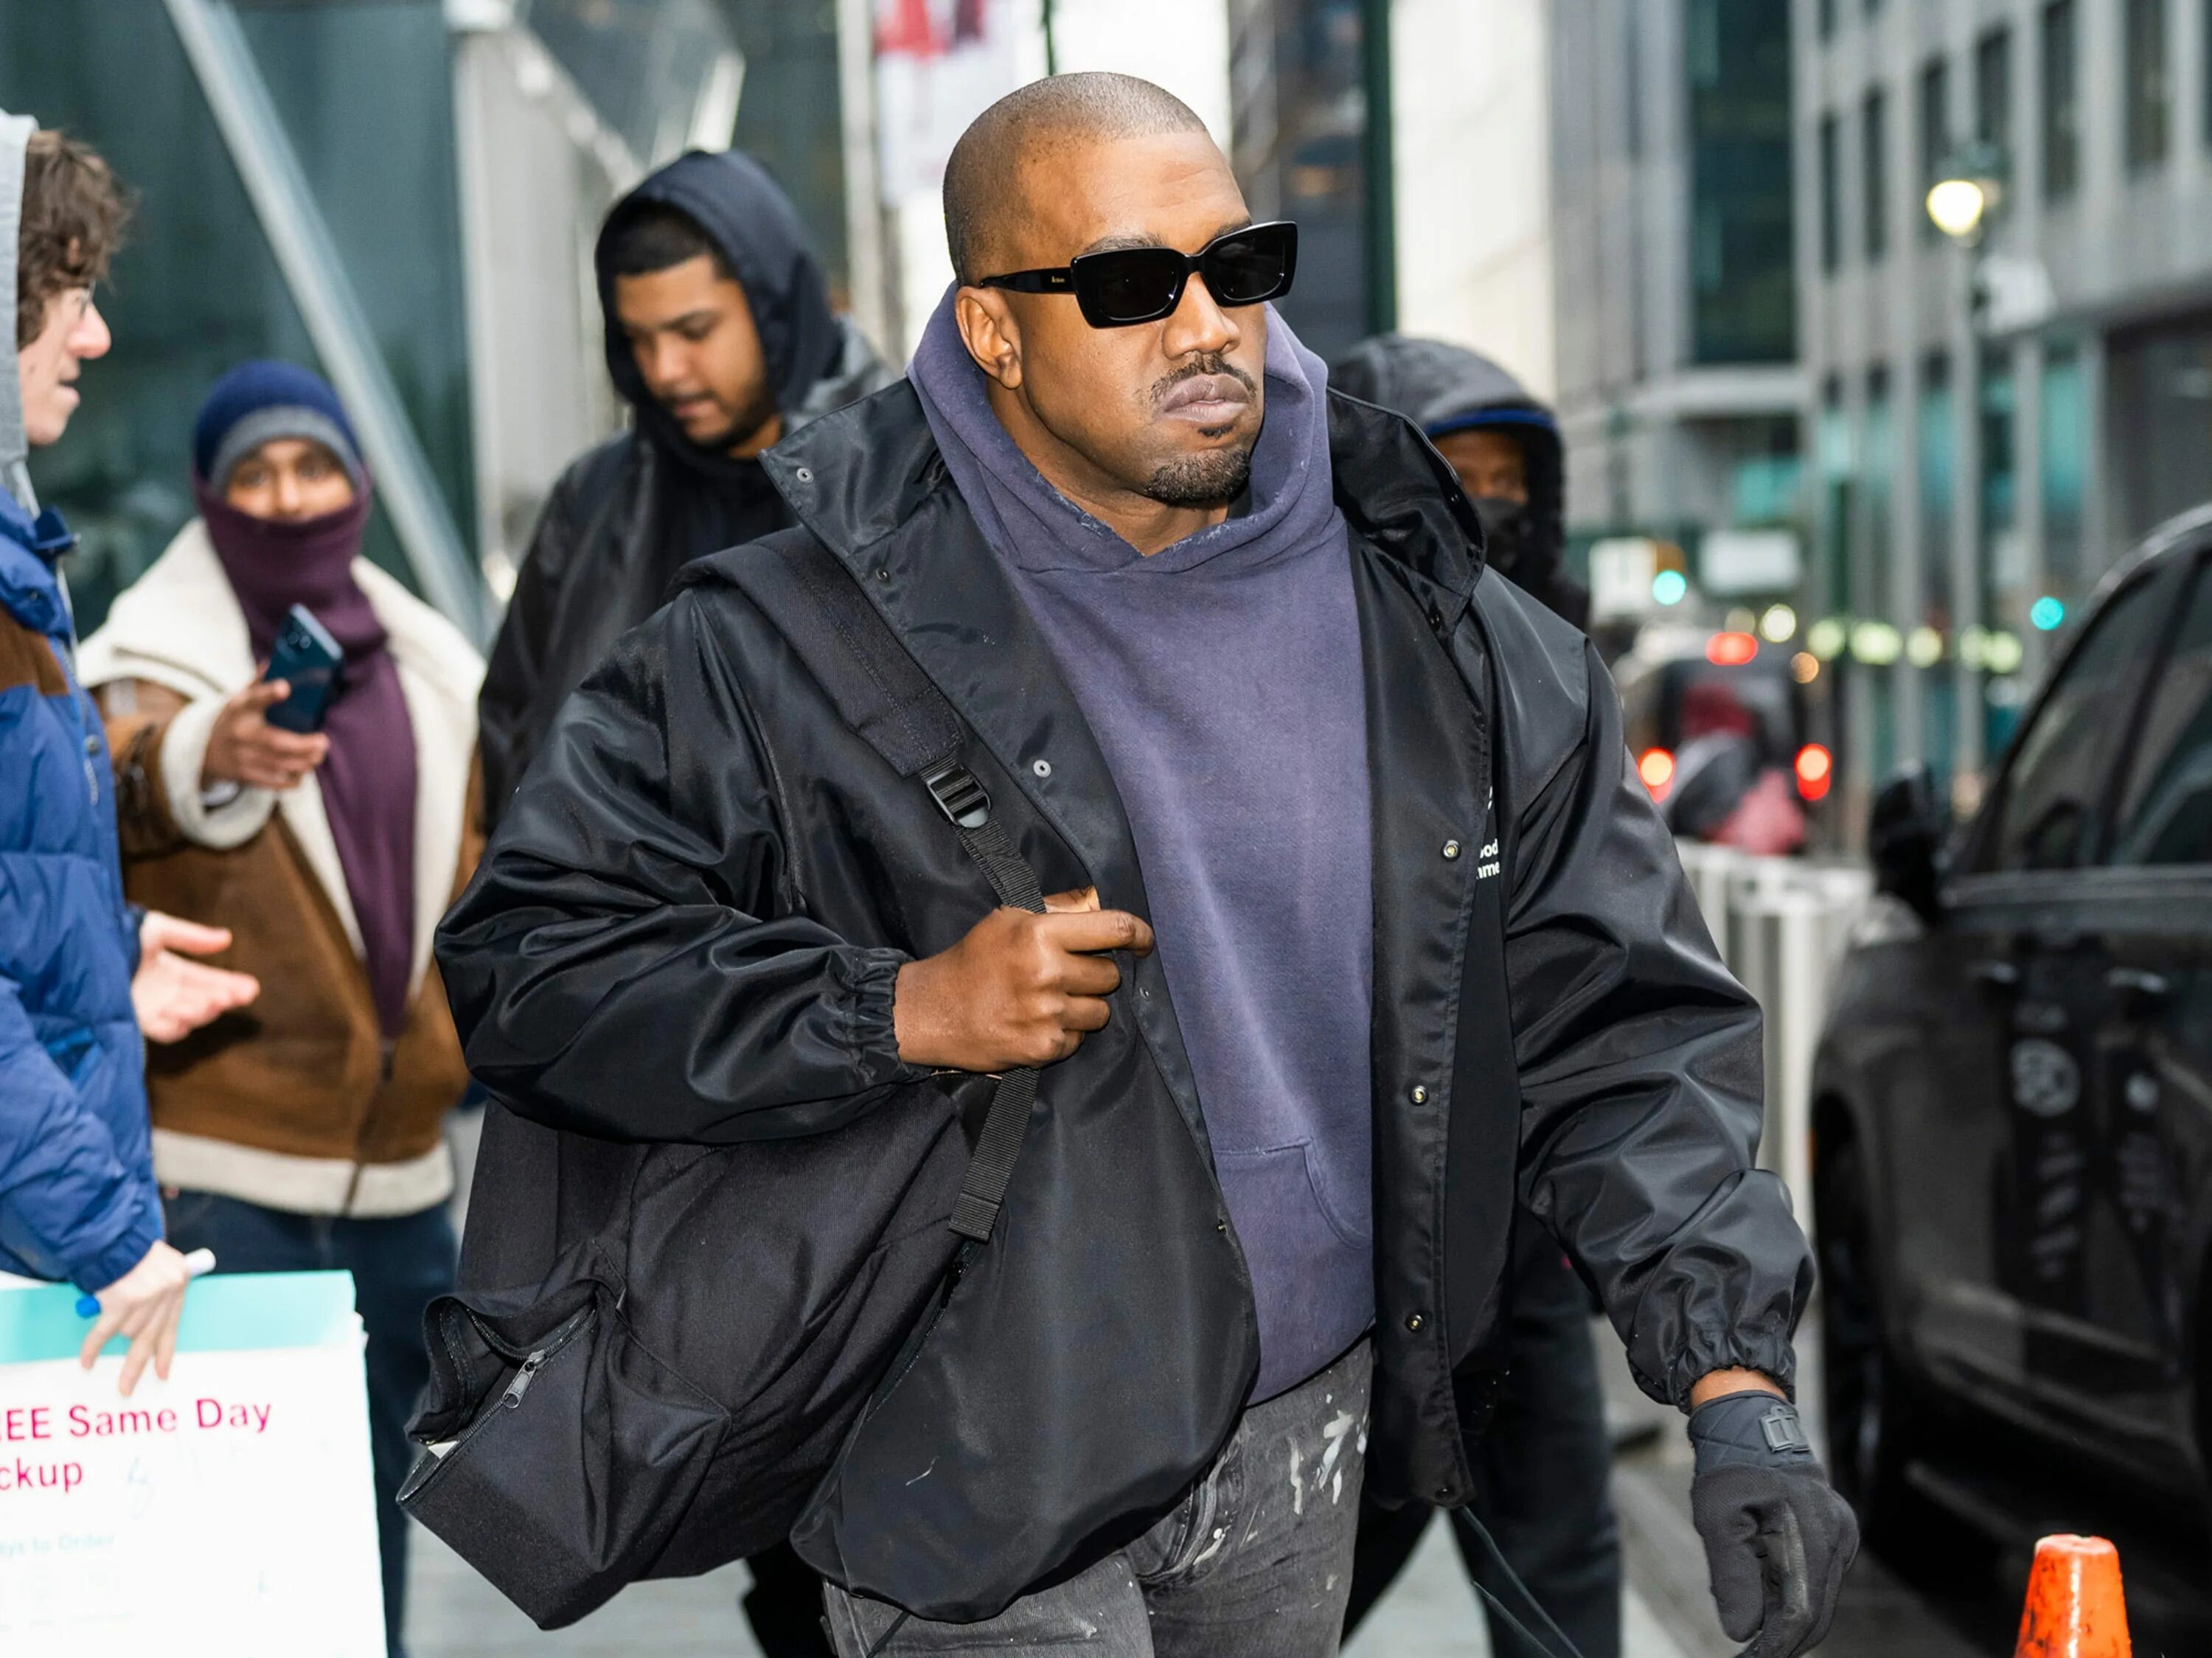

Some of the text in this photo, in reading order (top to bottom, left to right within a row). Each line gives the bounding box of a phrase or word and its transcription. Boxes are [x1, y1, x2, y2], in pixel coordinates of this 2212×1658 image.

[0, 1398, 272, 1441] EE Same Day
